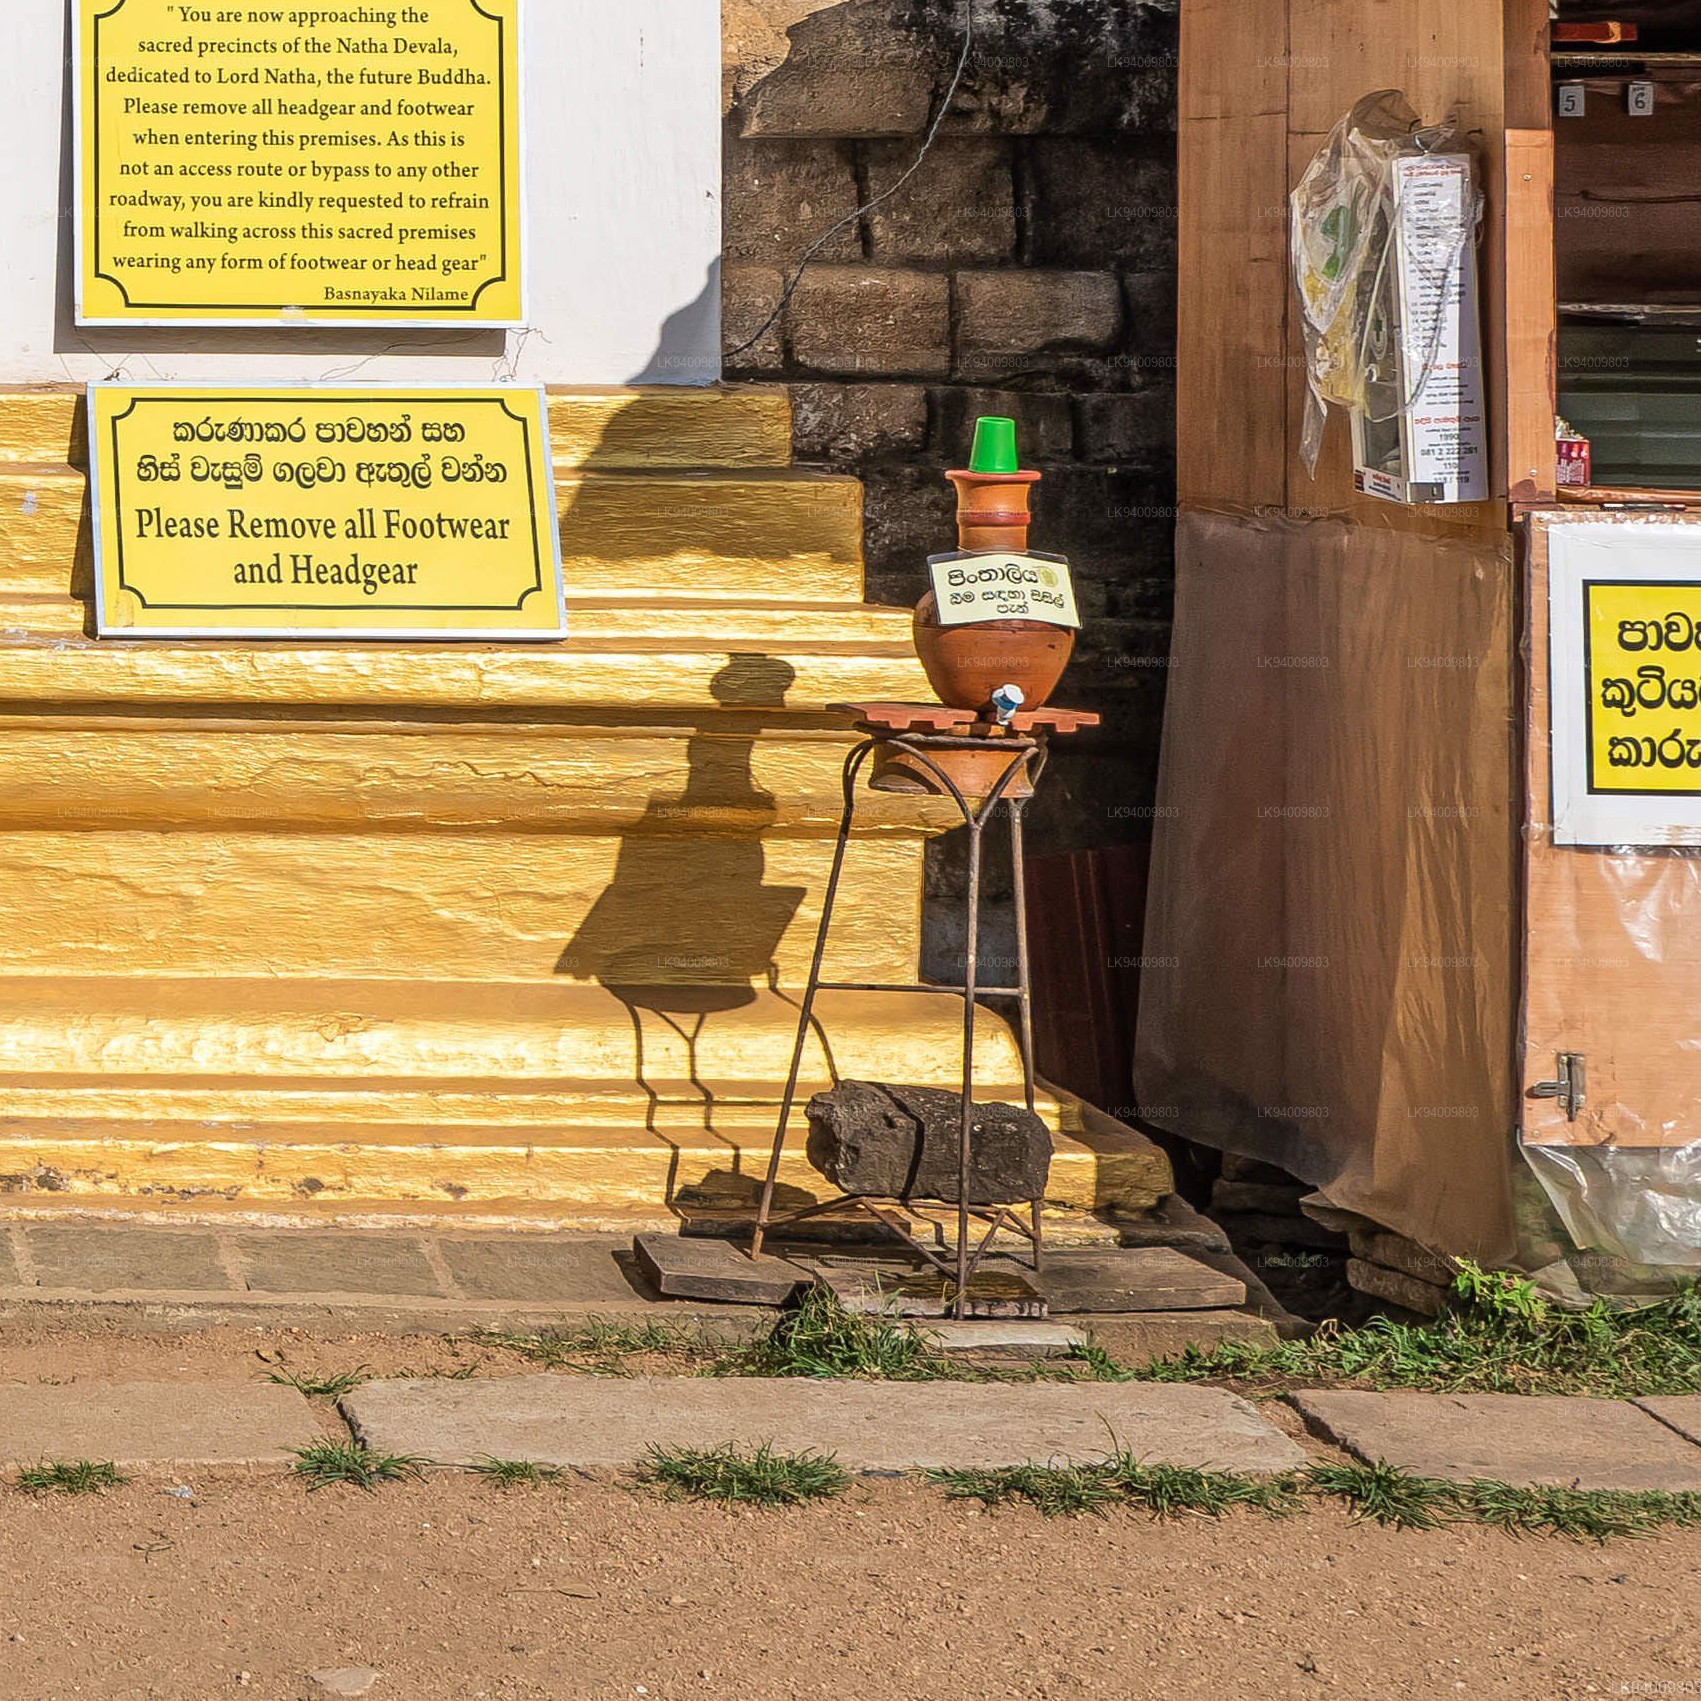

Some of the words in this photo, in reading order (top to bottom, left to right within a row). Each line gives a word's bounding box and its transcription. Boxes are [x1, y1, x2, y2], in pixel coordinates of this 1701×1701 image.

[217, 11, 243, 23] are
[248, 11, 284, 23] now
[288, 6, 397, 29] approaching
[401, 6, 429, 23] the
[139, 37, 192, 52] sacred
[199, 40, 276, 57] precincts
[283, 37, 301, 52] of
[305, 37, 330, 53] the
[337, 38, 387, 53] Natha
[394, 38, 457, 57] Devala,
[107, 67, 188, 82] dedicated
[196, 71, 211, 83] to
[218, 68, 258, 83] Lord
[265, 68, 320, 85] Natha,
[328, 69, 353, 84] the
[360, 68, 411, 84] future
[419, 69, 490, 84] Buddha.
[125, 98, 177, 114] Please
[184, 104, 246, 114] remove
[253, 99, 271, 114] all
[278, 99, 355, 120] headgear
[361, 99, 391, 115] and
[398, 99, 474, 115] footwear
[1564, 95, 1576, 112] 5
[1634, 92, 1646, 110] 6
[133, 129, 178, 144] when
[185, 132, 257, 150] entering
[263, 130, 293, 145] this
[300, 135, 380, 150] premises.
[387, 132, 408, 146] As
[415, 130, 445, 146] this
[452, 132, 464, 146] is
[121, 163, 148, 174] not
[154, 165, 173, 175] an
[180, 165, 231, 175] access
[238, 163, 282, 176] route
[289, 166, 306, 176] or
[312, 161, 369, 181] bypass
[375, 164, 391, 177] to
[398, 167, 427, 181] any
[433, 162, 478, 177] other
[111, 190, 185, 211] roadway,
[192, 197, 221, 211] you
[228, 197, 253, 207] are
[259, 191, 313, 212] kindly
[320, 192, 402, 212] requested
[410, 195, 425, 208] to
[432, 192, 488, 208] refrain
[125, 221, 164, 237] from
[171, 222, 237, 243] walking
[243, 228, 295, 238] across
[302, 223, 332, 238] this
[339, 223, 393, 238] sacred
[399, 229, 475, 244] premises
[114, 257, 180, 273] wearing
[186, 258, 213, 273] any
[222, 255, 262, 269] form
[268, 254, 286, 270] of
[289, 254, 368, 270] footwear
[373, 260, 391, 269] or
[396, 254, 436, 270] head
[325, 287, 405, 300] Basnayaka
[412, 288, 468, 300] Nilame
[174, 417, 305, 442] කරුණාකර
[316, 414, 411, 442] පාවහන්
[422, 423, 465, 442] සහ
[137, 453, 180, 481] හිස්
[191, 454, 262, 489] වැසුම්
[273, 457, 345, 489] ගලවා
[356, 454, 431, 488] ඇතුල්
[442, 454, 506, 482] වන්න
[136, 508, 218, 538] Please
[228, 510, 335, 538] Remove
[345, 508, 376, 538] all
[383, 510, 509, 539] Footwear
[235, 553, 282, 583] and
[290, 554, 417, 595] Headgear
[1617, 611, 1701, 652] පාව
[1601, 665, 1701, 717] කුටිය
